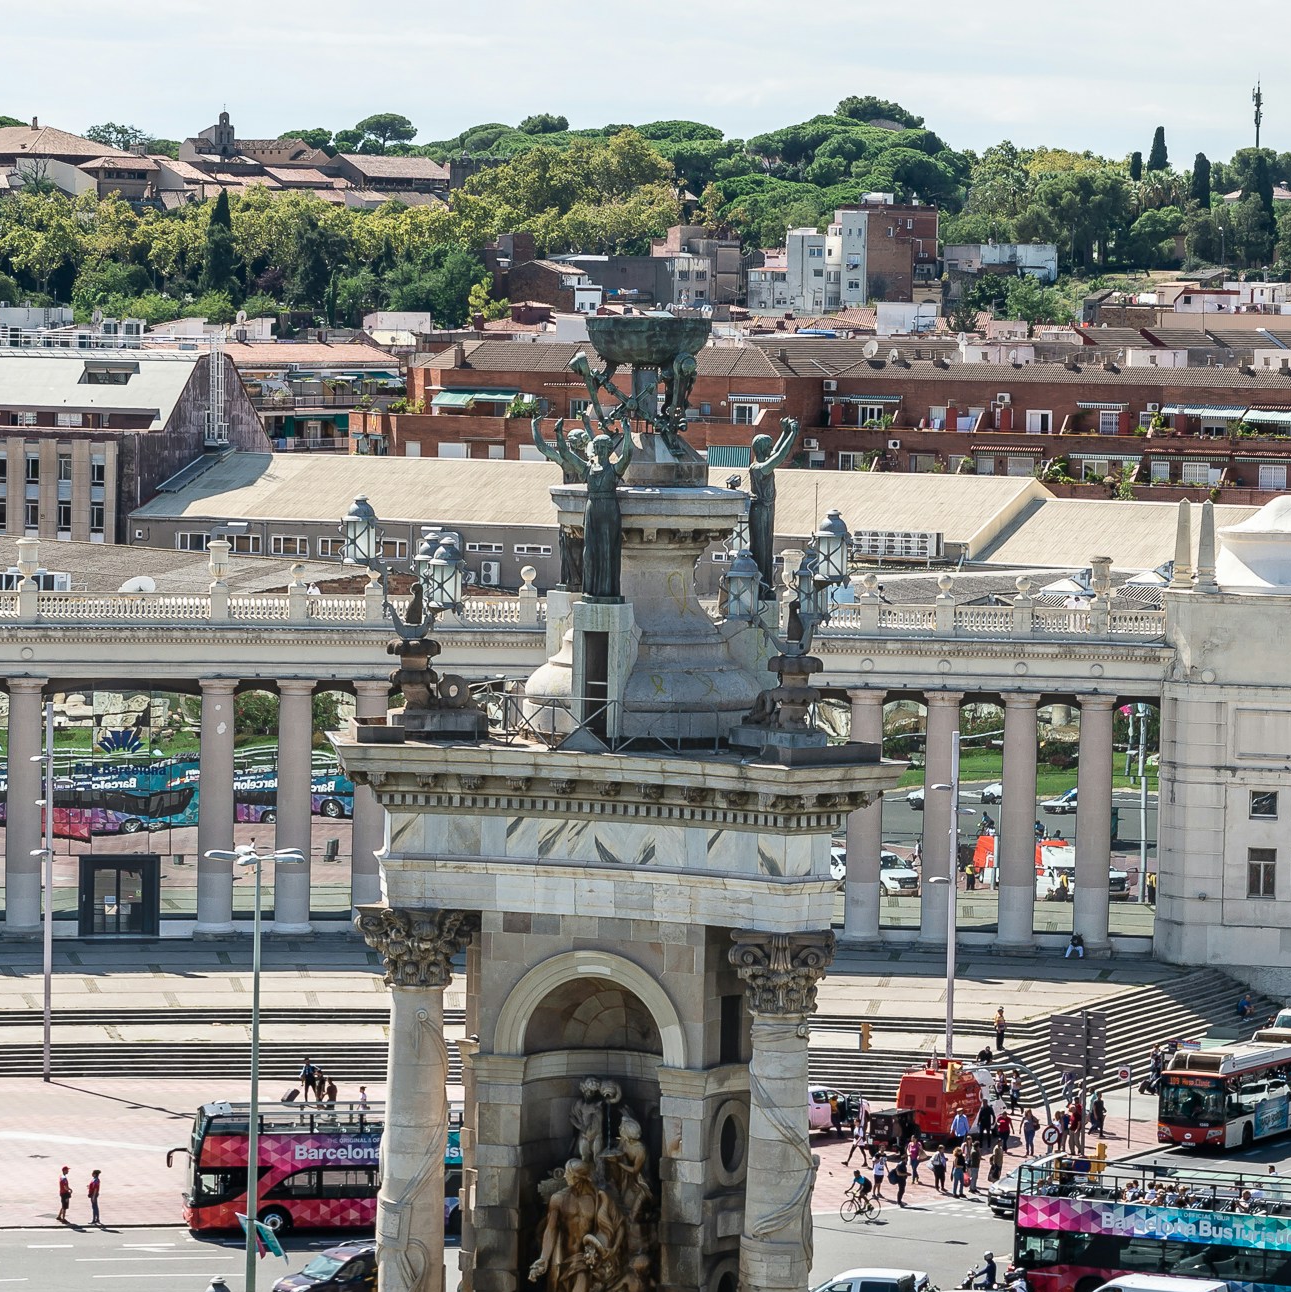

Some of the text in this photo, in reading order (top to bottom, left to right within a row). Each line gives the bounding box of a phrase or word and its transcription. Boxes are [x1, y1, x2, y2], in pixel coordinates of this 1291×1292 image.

[103, 763, 167, 776] Barcelona
[294, 1144, 381, 1160] Barcelona
[1101, 1211, 1197, 1237] Barcelona
[1183, 1212, 1211, 1221] OFFICIAL
[1211, 1214, 1231, 1222] TOUR
